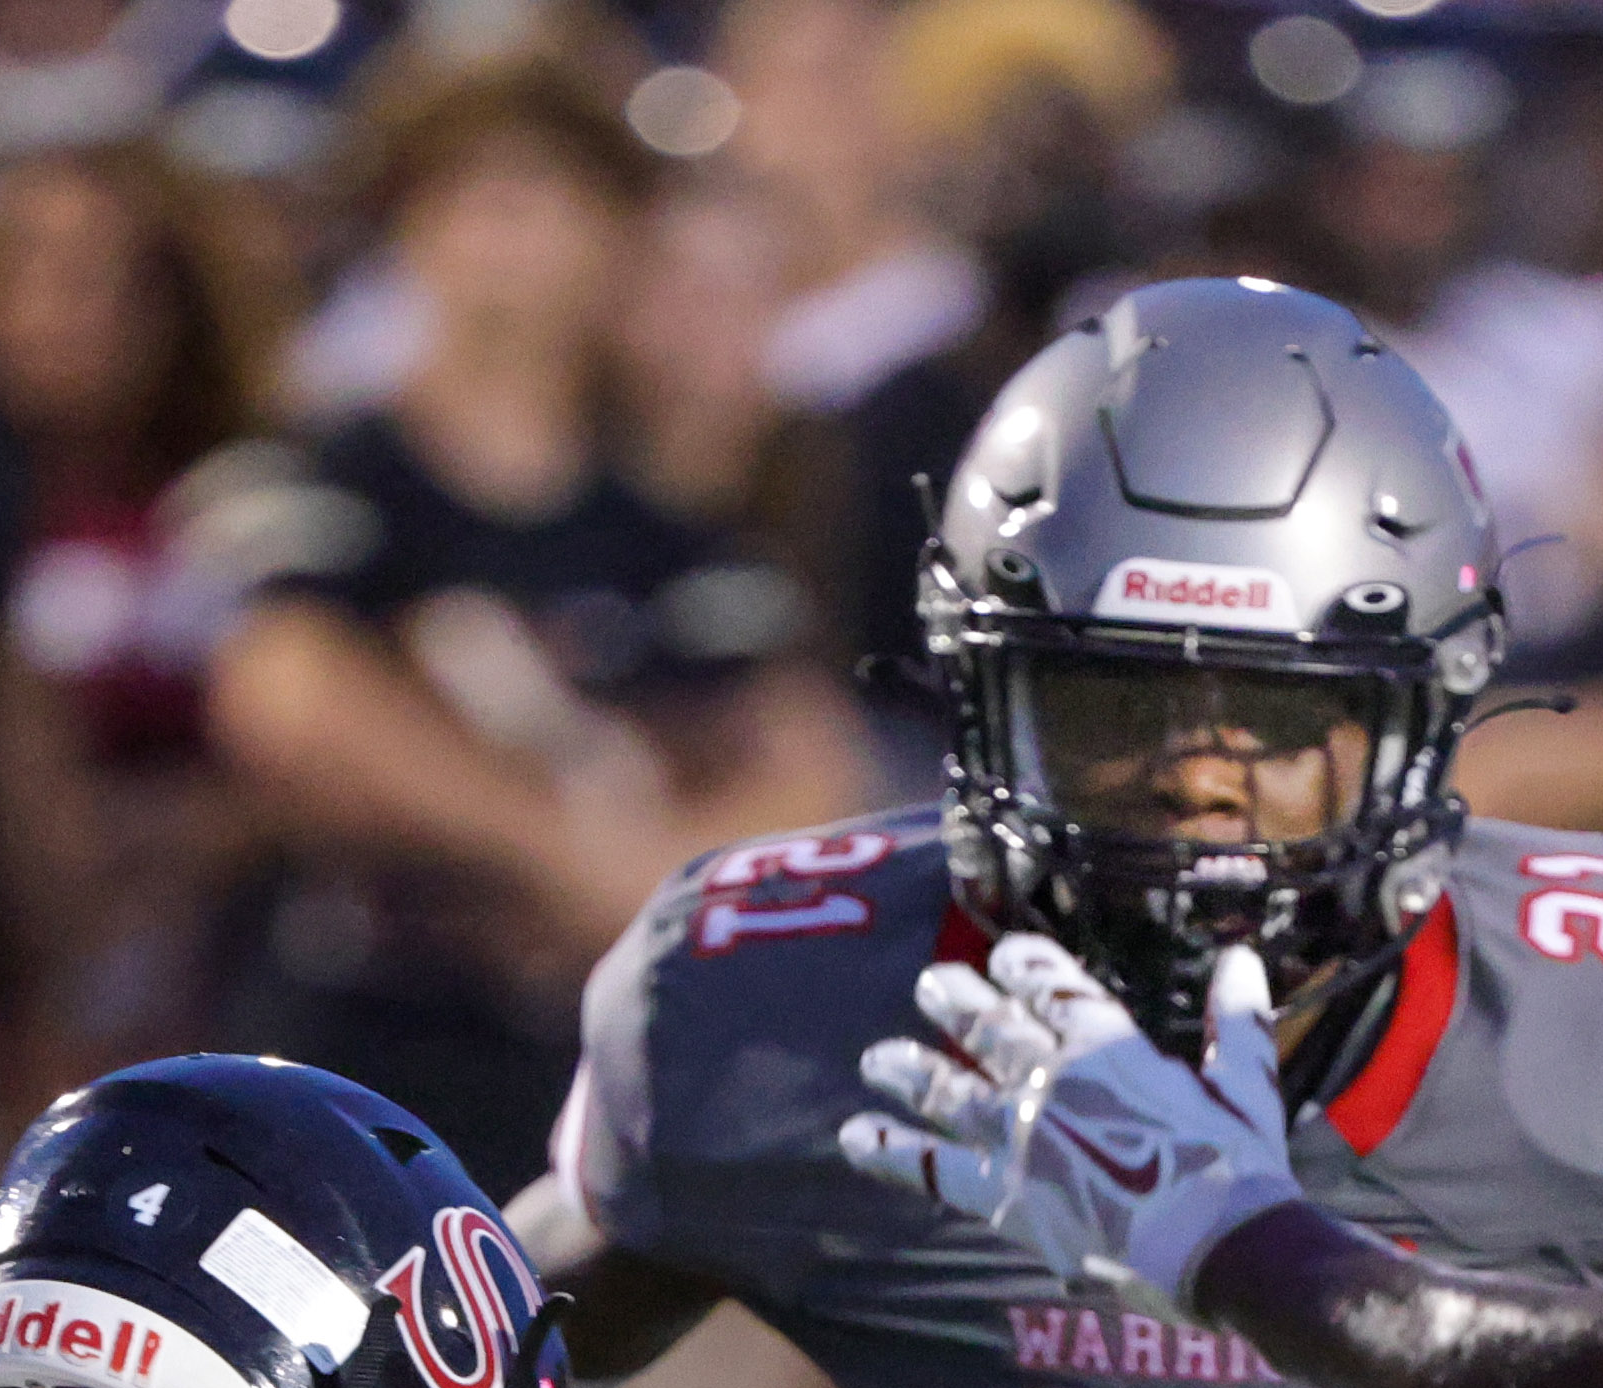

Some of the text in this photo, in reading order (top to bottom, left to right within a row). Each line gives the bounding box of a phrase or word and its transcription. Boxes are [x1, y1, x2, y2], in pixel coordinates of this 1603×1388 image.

[1124, 571, 1272, 609] Riddell
[691, 832, 895, 961] 21
[128, 1183, 171, 1226] 4
